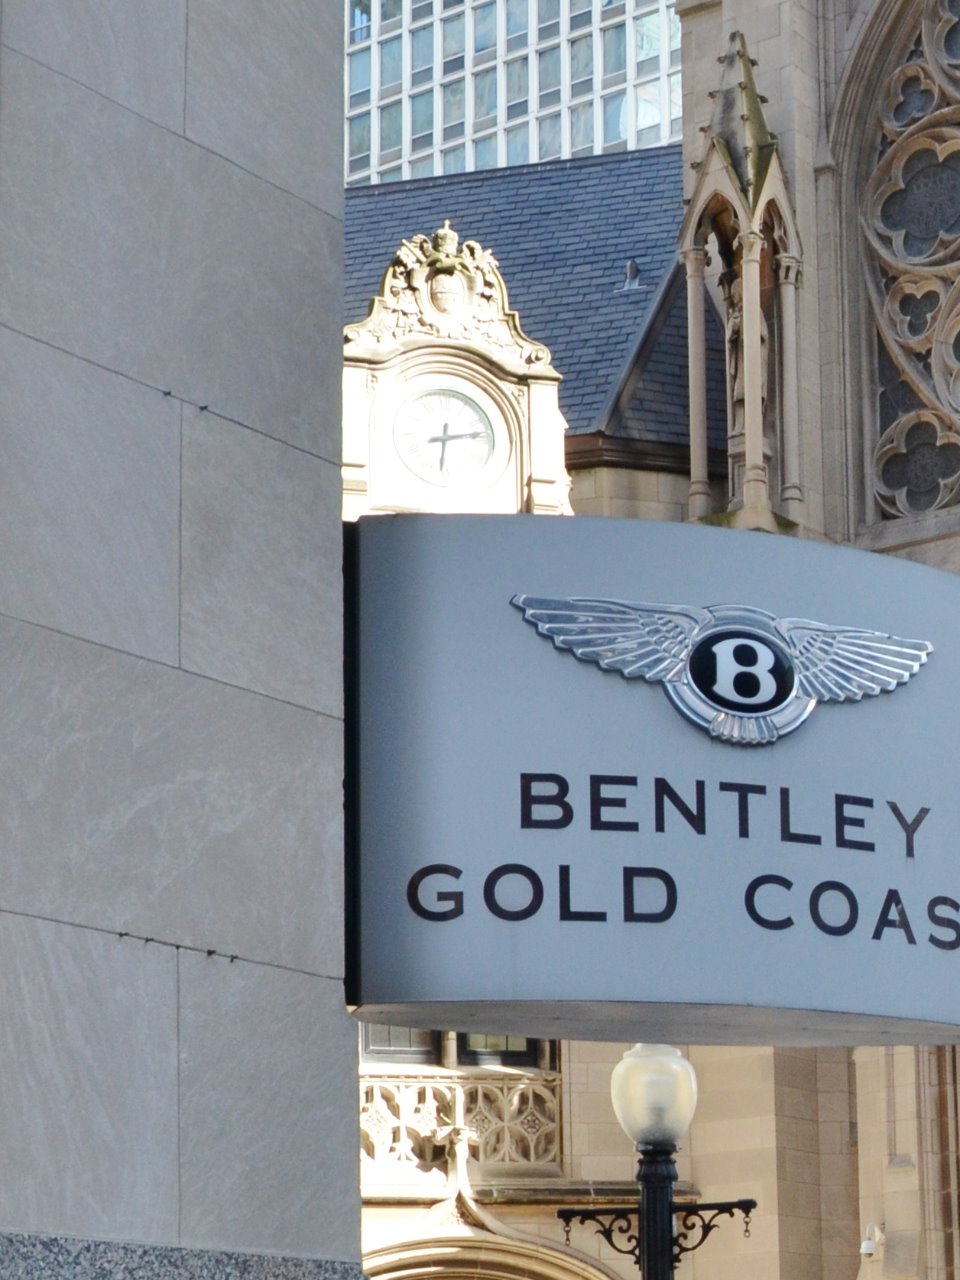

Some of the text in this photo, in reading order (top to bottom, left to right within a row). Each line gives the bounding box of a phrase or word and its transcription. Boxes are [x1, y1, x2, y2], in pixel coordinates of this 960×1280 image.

[713, 638, 777, 705] B
[519, 772, 932, 859] BENTLEY
[405, 863, 679, 924] GOLD
